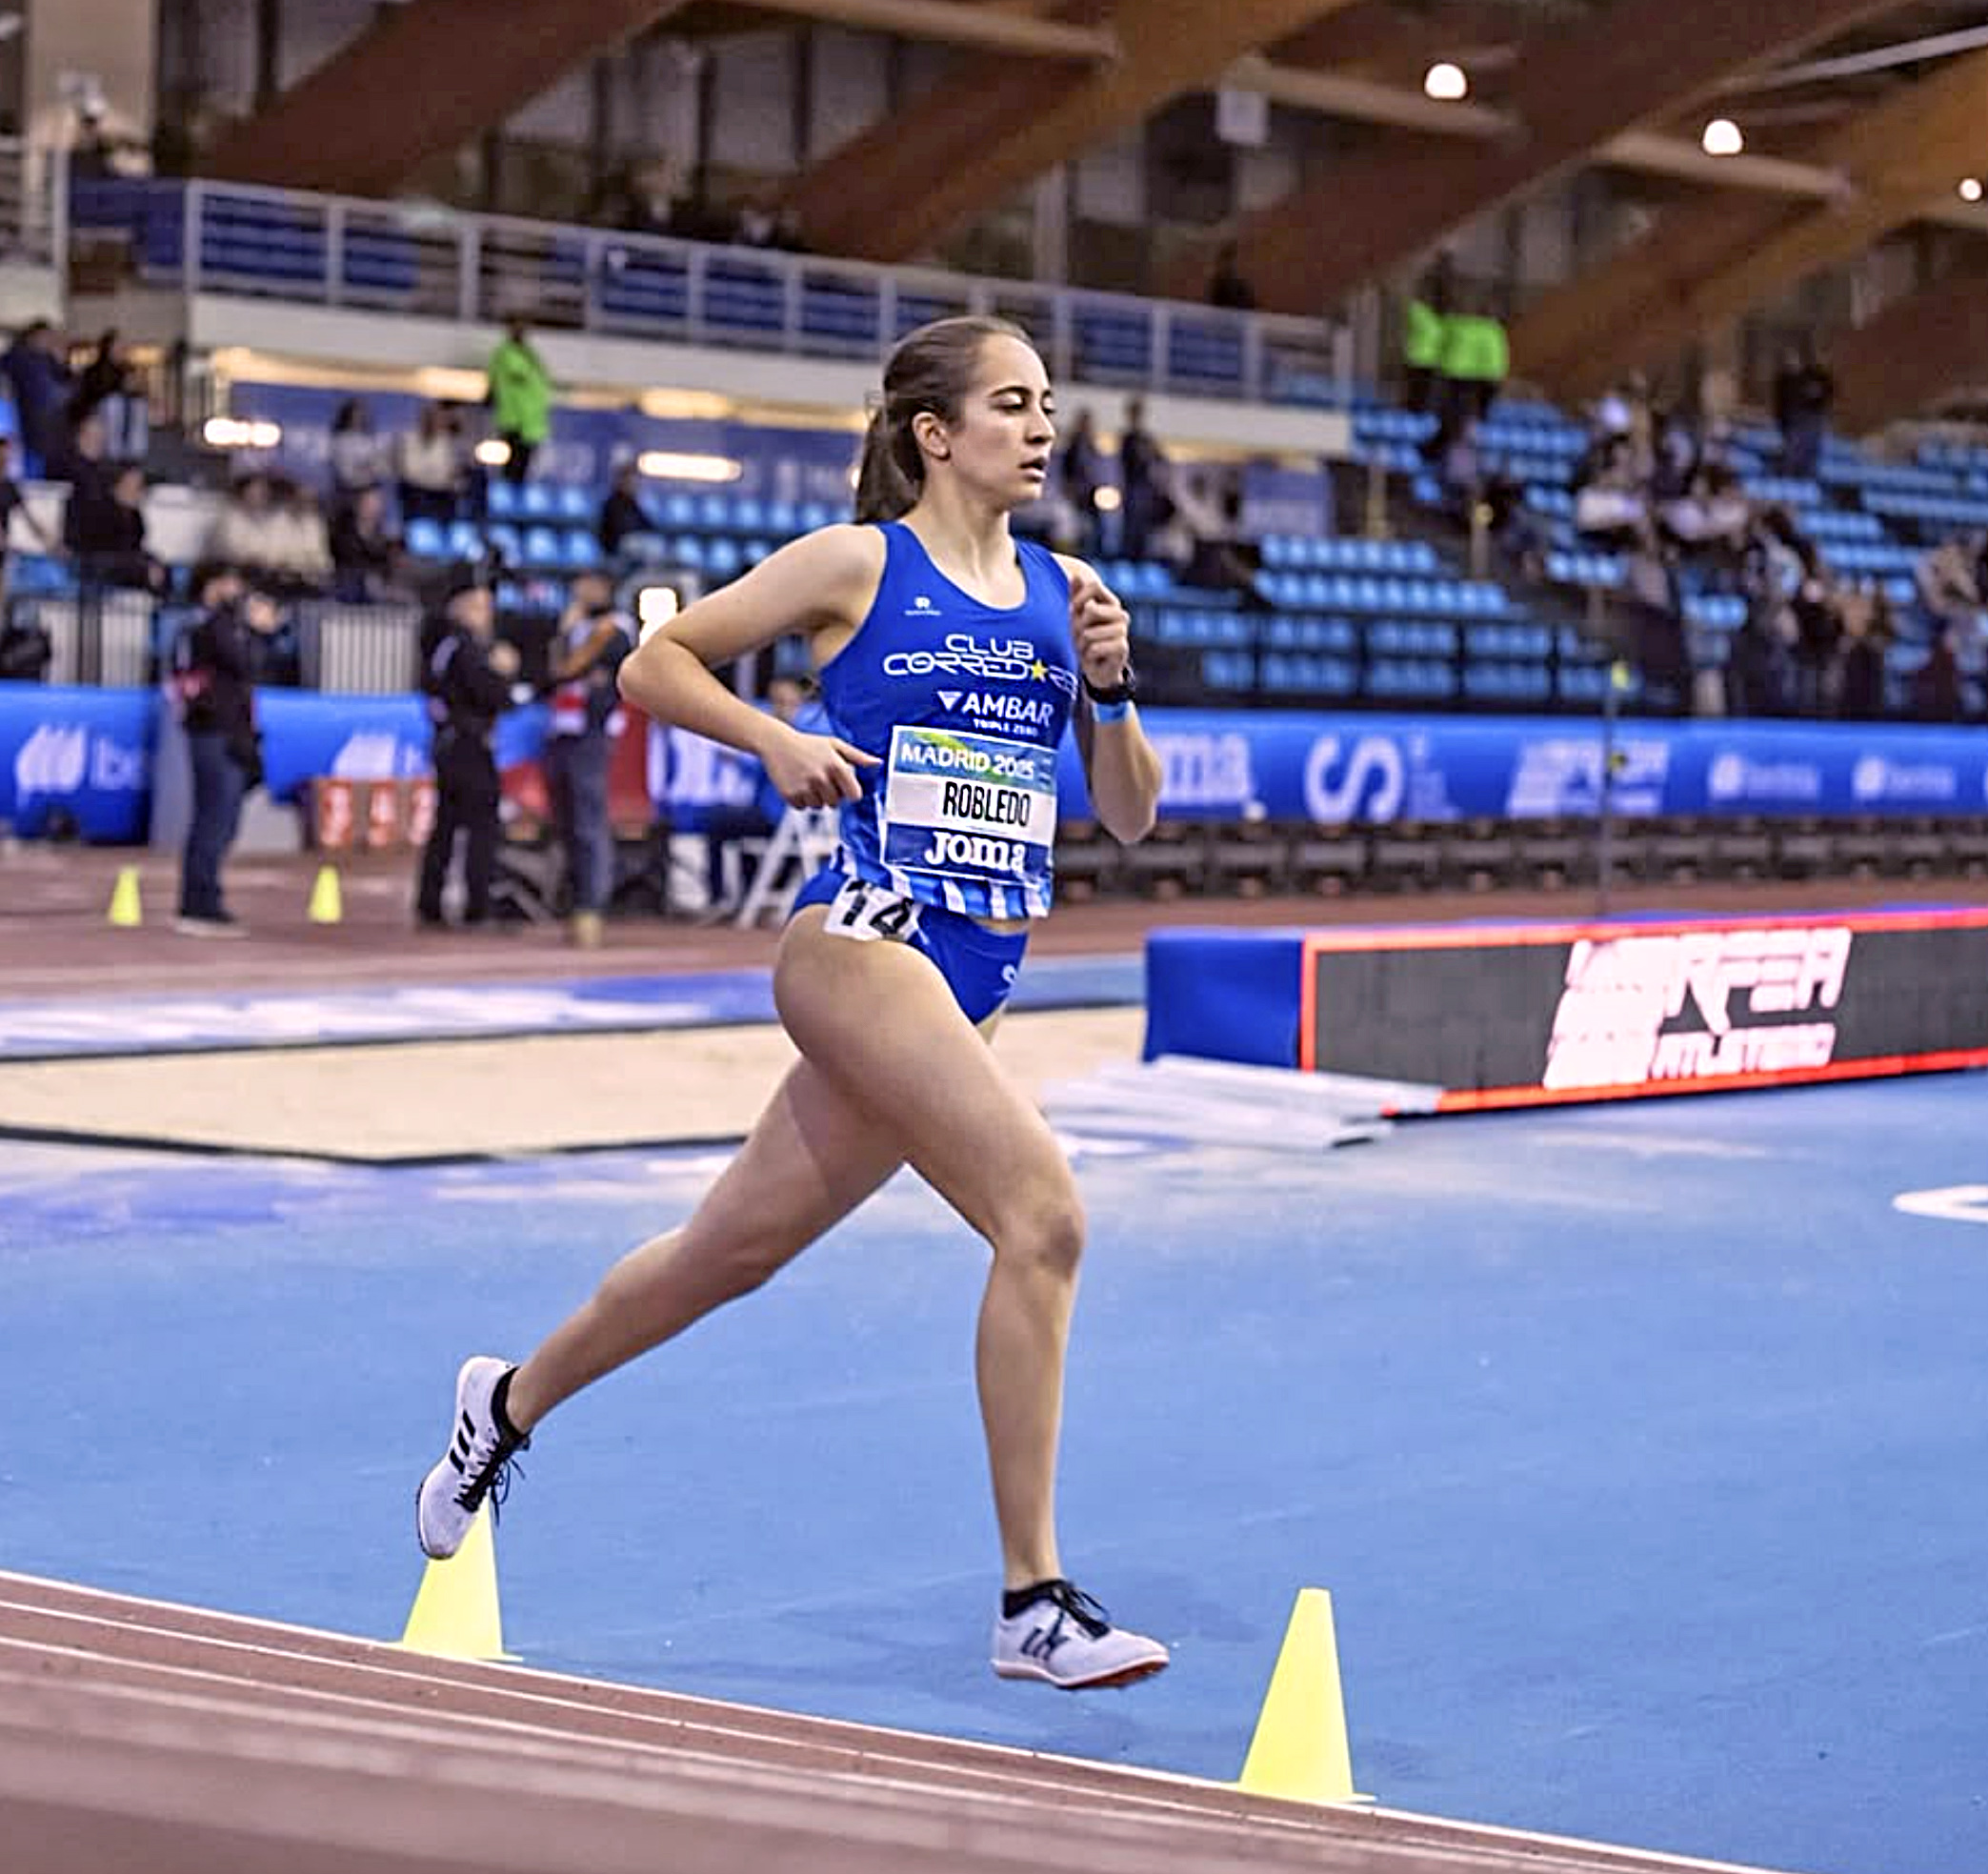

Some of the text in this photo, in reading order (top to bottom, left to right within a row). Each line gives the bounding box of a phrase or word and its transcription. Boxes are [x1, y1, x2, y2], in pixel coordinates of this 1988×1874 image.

[945, 633, 1034, 659] CLUB
[961, 693, 1054, 727] AMBAR
[901, 743, 991, 772] MADRID
[942, 781, 1032, 827] ROBLEDO
[924, 831, 1026, 874] Joma
[842, 878, 914, 936] 14
